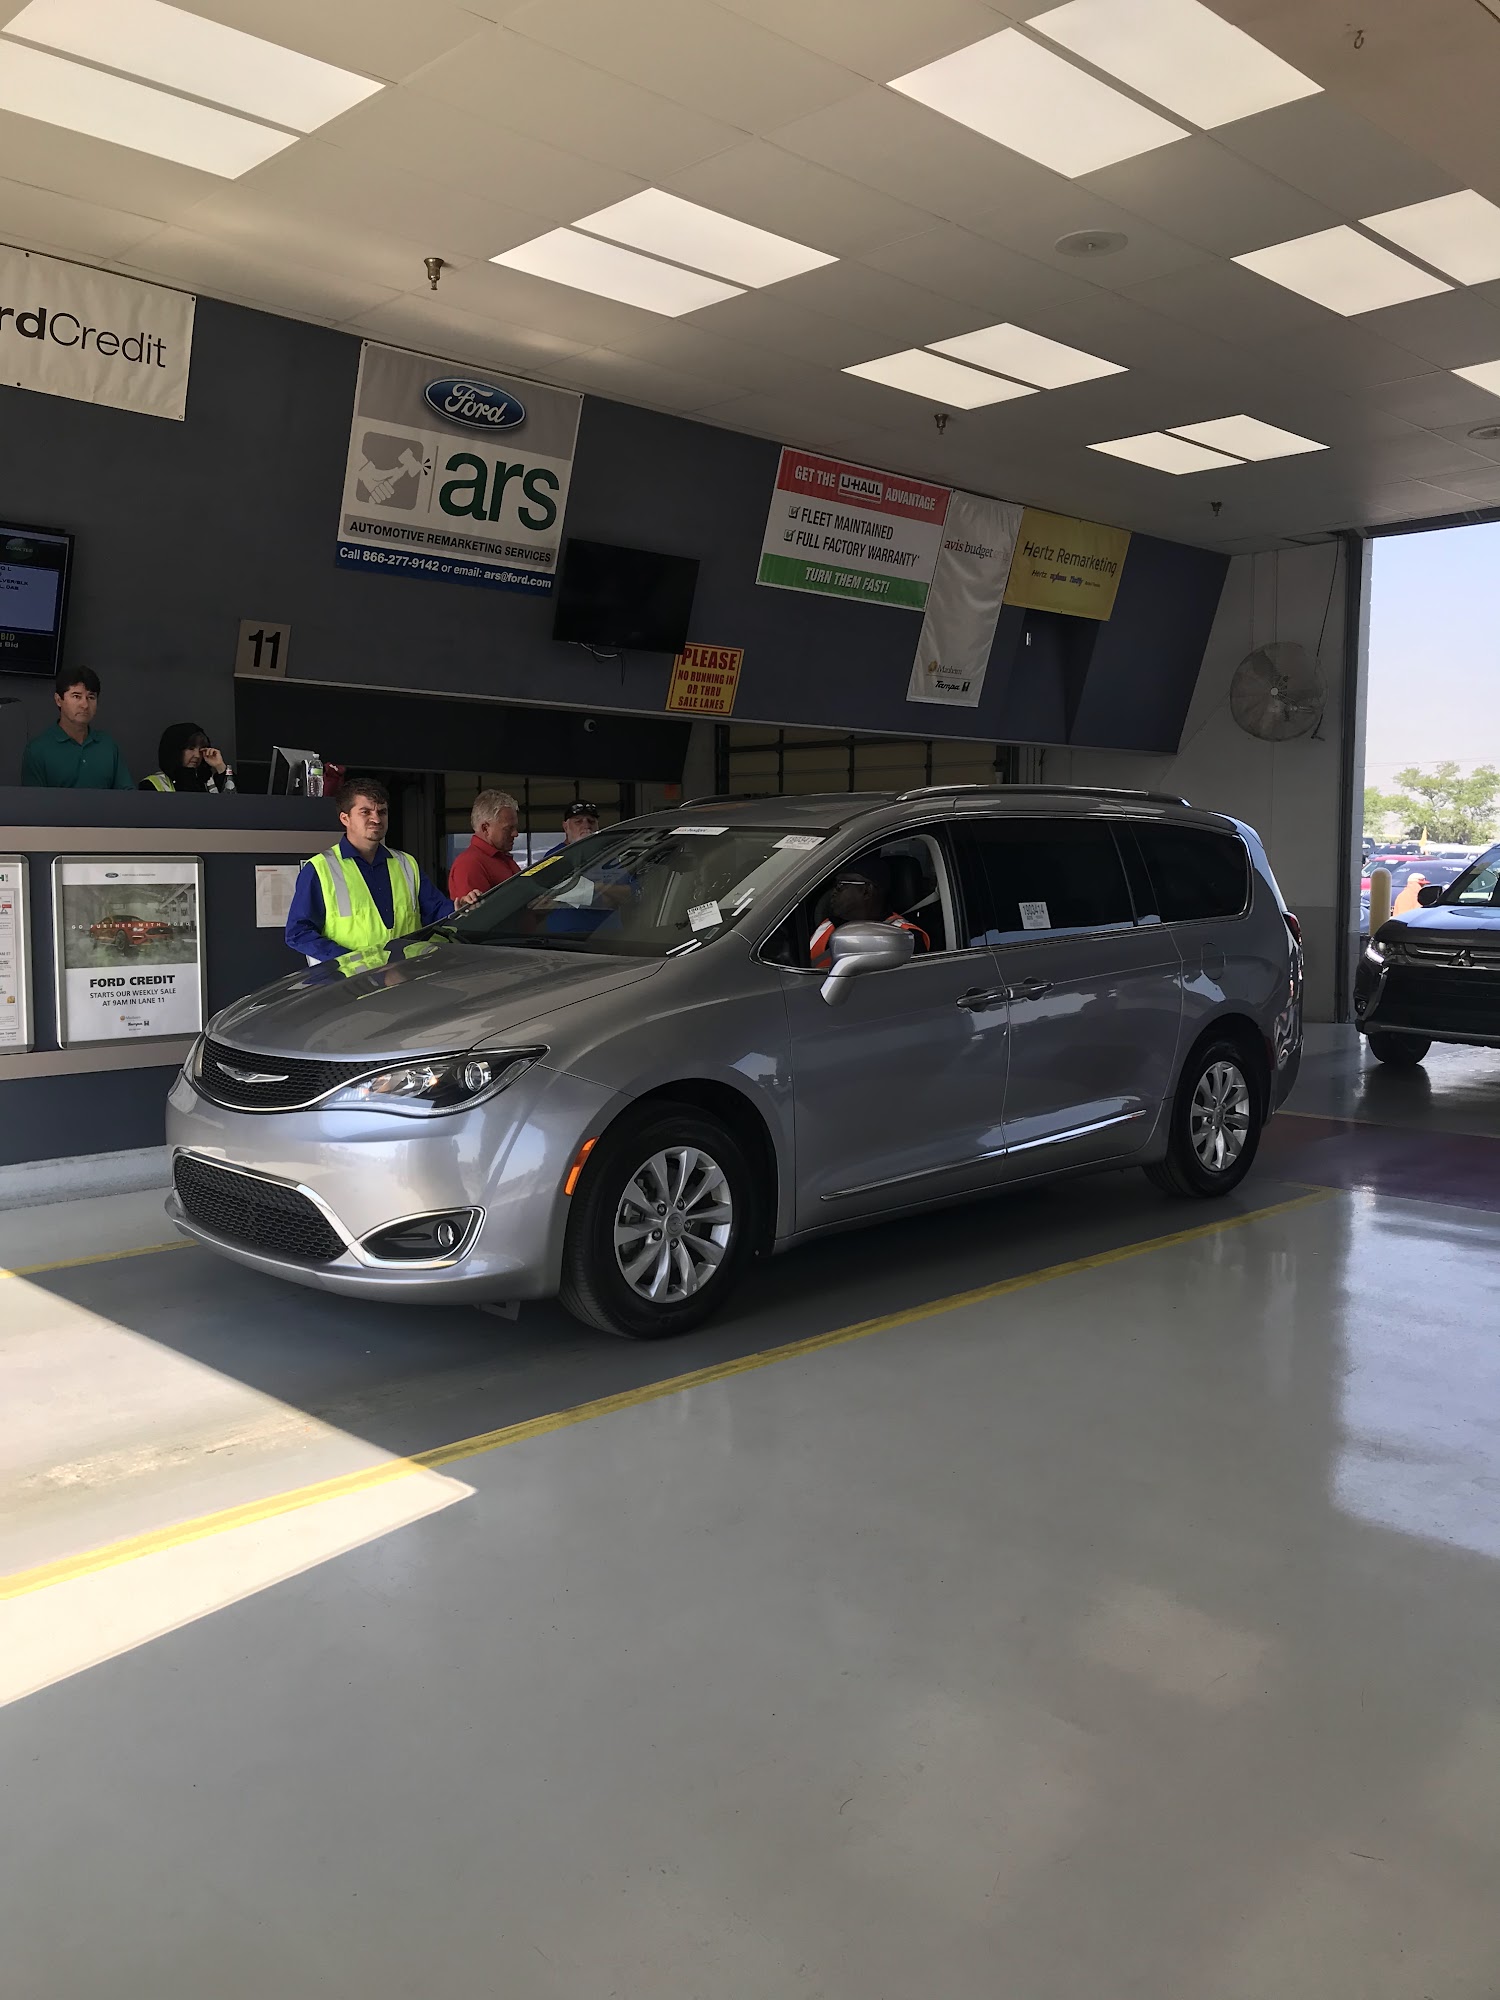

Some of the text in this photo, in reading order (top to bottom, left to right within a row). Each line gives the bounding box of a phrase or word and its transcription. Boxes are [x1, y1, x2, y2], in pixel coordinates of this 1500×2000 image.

[444, 383, 508, 423] Ford
[439, 452, 560, 531] ars
[794, 465, 815, 482] GET
[817, 470, 836, 488] THE
[885, 487, 936, 511] ADVANTAGE
[801, 507, 894, 540] FLEET MAINTAINED
[350, 521, 551, 562] AUTOMOTIVE REMARKETING SERVICES
[796, 530, 820, 549] FULL
[822, 535, 866, 558] FACTORY
[944, 539, 964, 552] avis
[964, 541, 994, 559] budget
[339, 547, 552, 589] Call 866-277-9142 or email: ars@ford.com
[1022, 540, 1055, 561] Hertz
[1056, 548, 1118, 578] Remarketing
[805, 566, 890, 594] TURN THEM FAST!
[0, 632, 15, 642] BID
[248, 629, 281, 669] 11
[681, 648, 738, 671] PLEASE
[678, 669, 735, 686] NO RUNNING IN
[935, 680, 961, 692] Tampa
[687, 684, 721, 697] OR THRU
[678, 696, 724, 710] SALE LANES
[1022, 903, 1045, 916] 1903414
[89, 975, 175, 988] FORD CREDIT
[89, 991, 115, 999] STARTS
[132, 988, 159, 996] WEEKLY
[160, 987, 177, 995] SALE
[138, 997, 156, 1005] LANE
